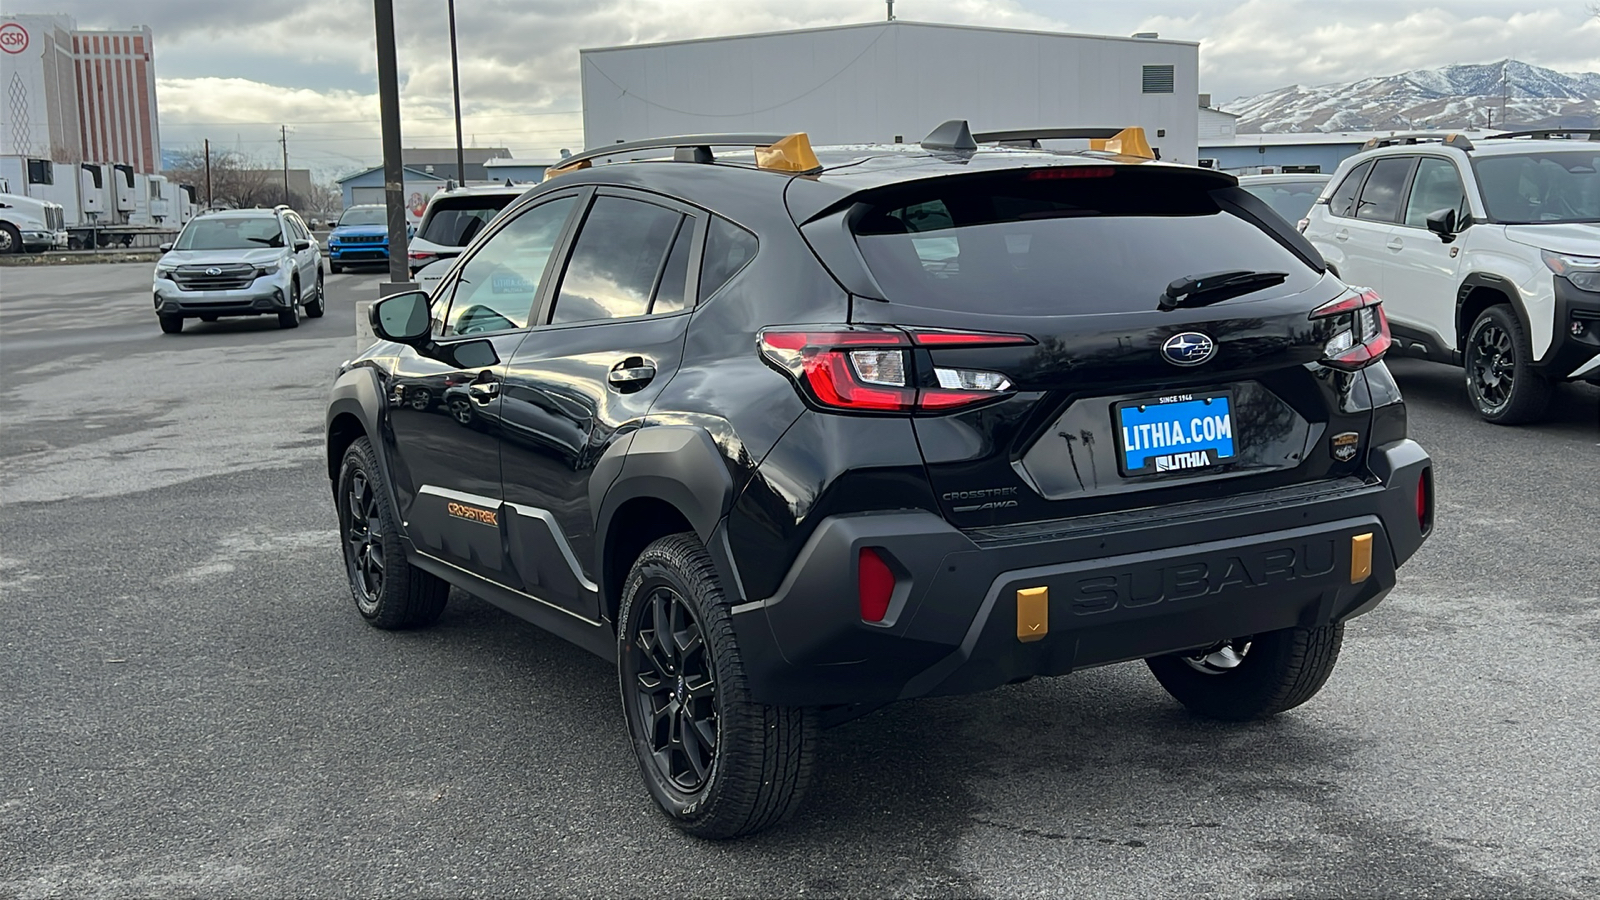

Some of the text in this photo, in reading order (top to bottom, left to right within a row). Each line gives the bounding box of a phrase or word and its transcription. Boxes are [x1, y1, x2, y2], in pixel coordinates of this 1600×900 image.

[0, 33, 24, 45] GSR
[1159, 396, 1178, 404] SINCE
[1122, 414, 1232, 452] LITHIA.COM
[1168, 451, 1210, 470] LITHIA
[942, 486, 1018, 500] CROSSTREK
[979, 500, 1018, 510] AWD
[447, 502, 498, 526] CROSSTREK
[1073, 540, 1335, 616] SUBARU
